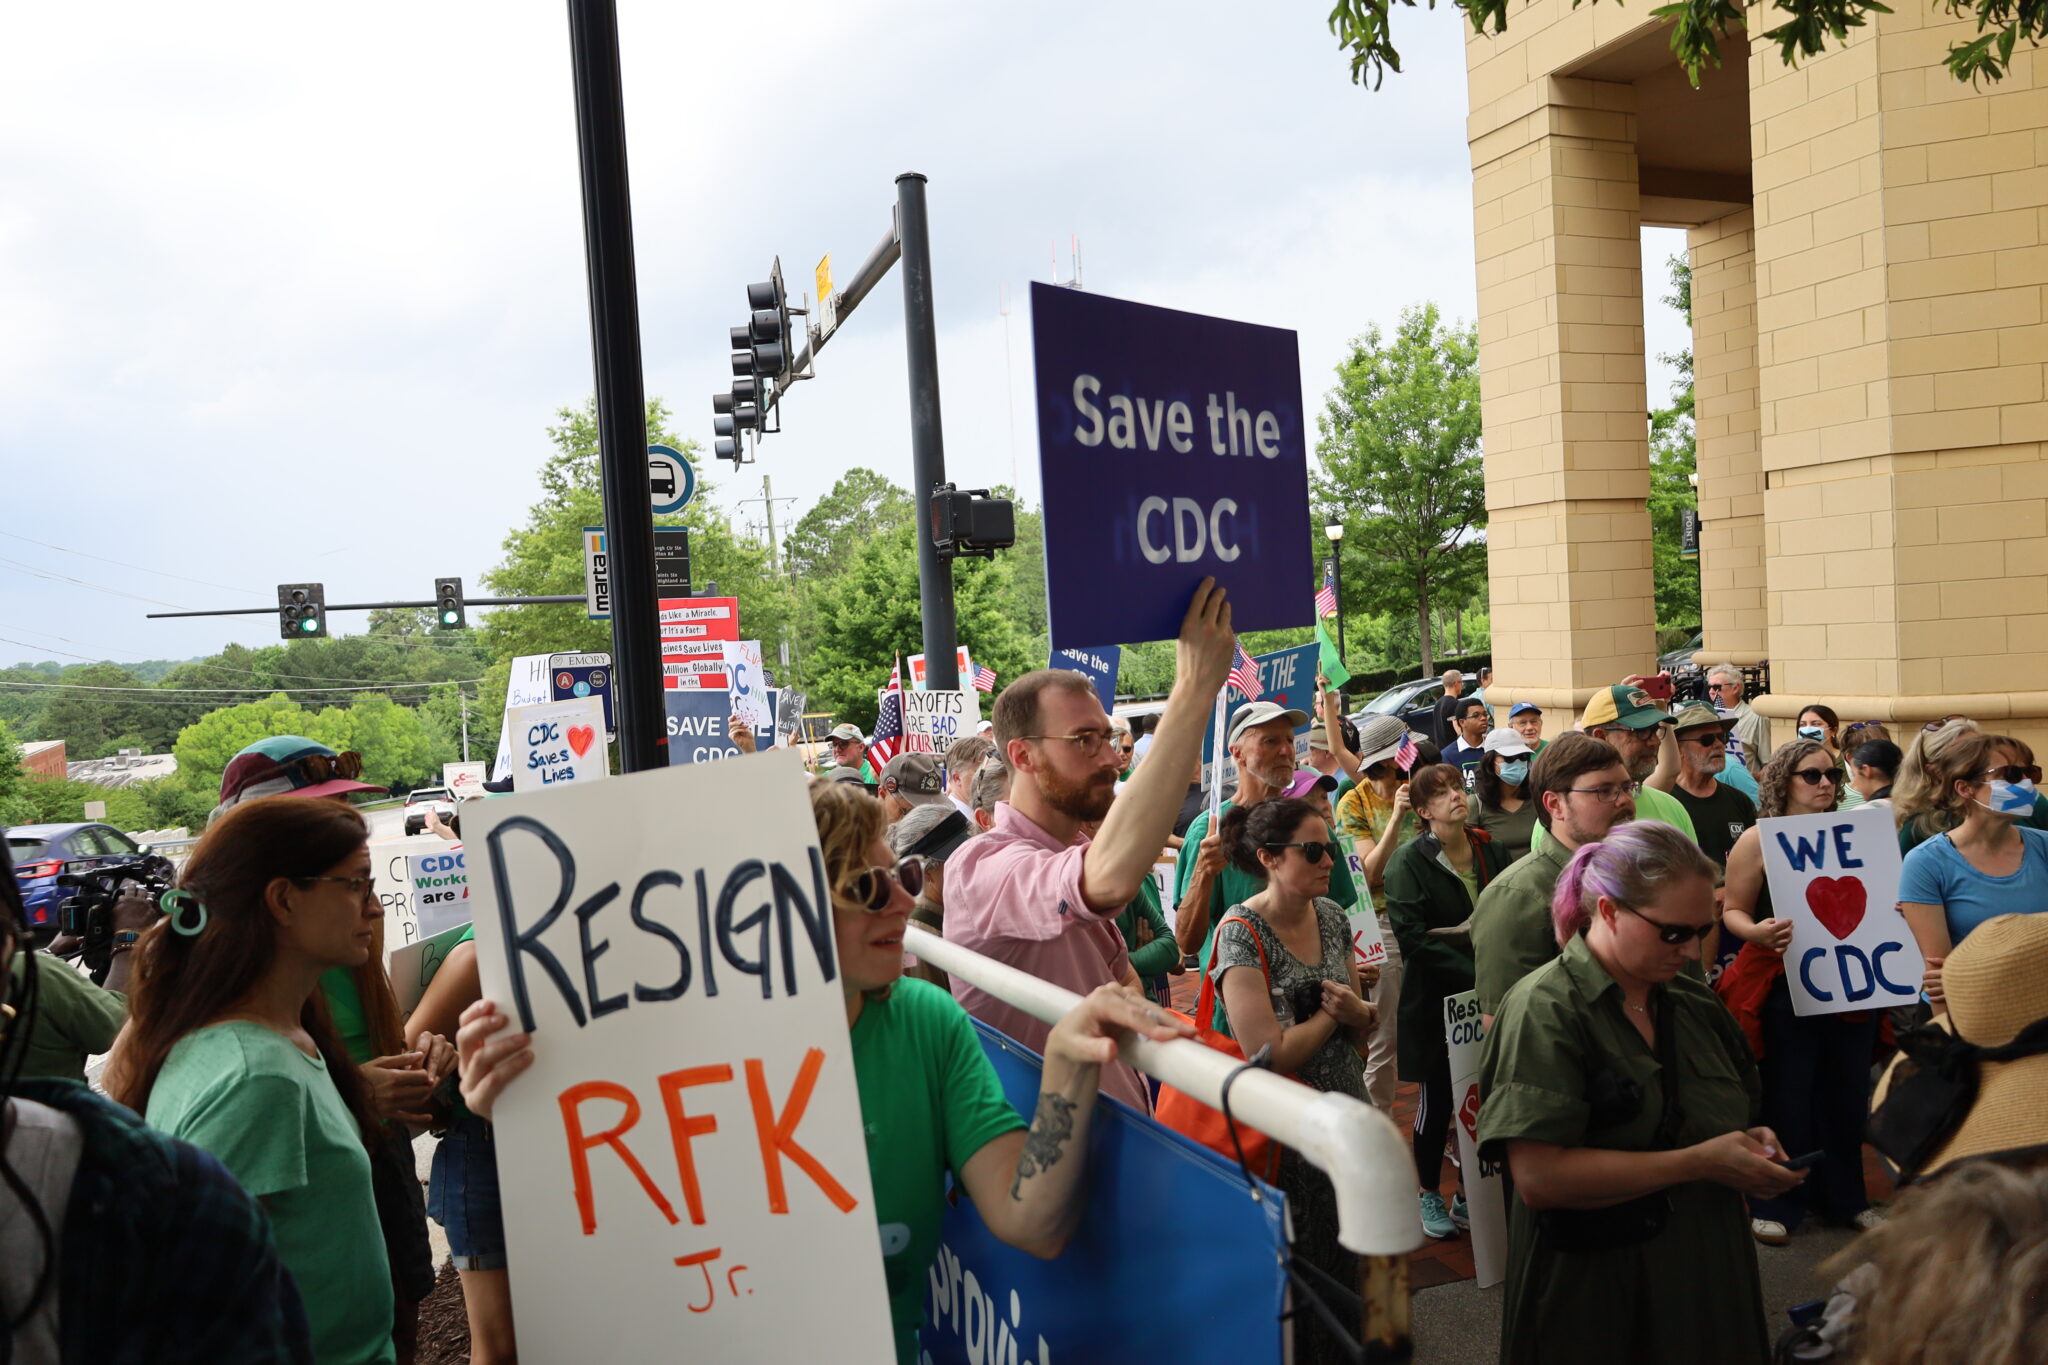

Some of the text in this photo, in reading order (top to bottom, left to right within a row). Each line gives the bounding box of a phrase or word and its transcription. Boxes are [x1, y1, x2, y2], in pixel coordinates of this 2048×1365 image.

[1072, 373, 1281, 459] Save the
[1136, 495, 1241, 565] CDC
[593, 554, 609, 611] marta
[662, 643, 723, 653] cines Save Lives
[568, 655, 607, 666] EMORY
[692, 661, 723, 673] Globally
[1091, 654, 1109, 674] the
[560, 675, 570, 686] A
[1271, 653, 1300, 692] THE
[511, 689, 548, 706] Budget
[527, 721, 560, 747] CDC
[666, 716, 721, 737] SAVE
[930, 715, 958, 736] BAD
[526, 748, 570, 771] Saves
[542, 765, 575, 785] Lives
[1776, 824, 1864, 872] WE
[422, 891, 456, 905] are
[486, 815, 837, 1033] RESIGN
[1369, 942, 1384, 957] JR
[1800, 941, 1916, 1003] CDC
[1452, 1019, 1485, 1046] CDC
[557, 1046, 858, 1236] RFK
[673, 1246, 754, 1313] Jr.
